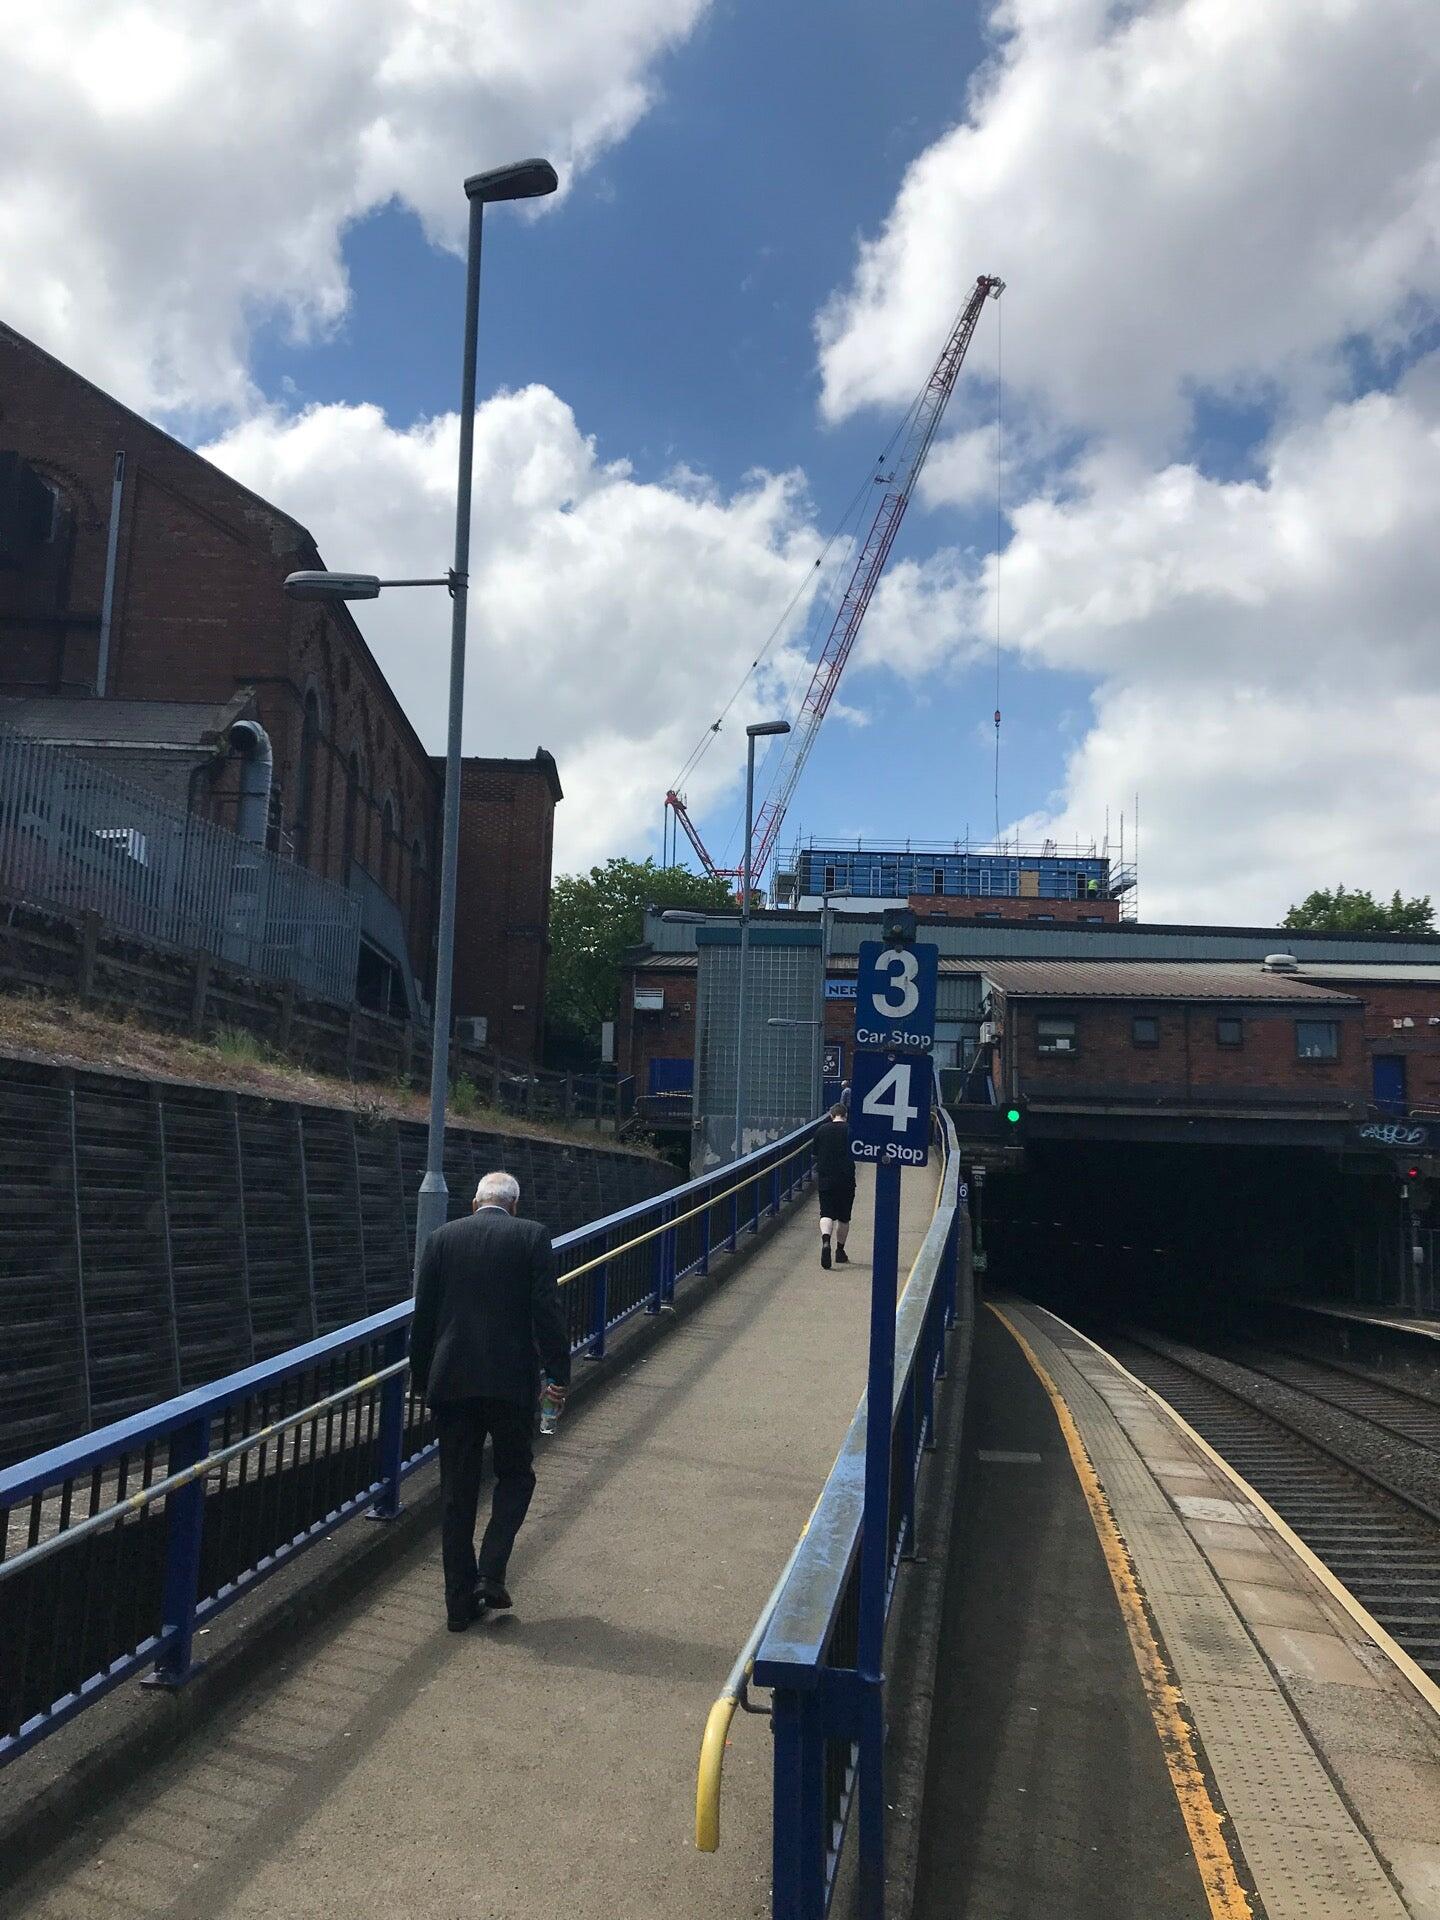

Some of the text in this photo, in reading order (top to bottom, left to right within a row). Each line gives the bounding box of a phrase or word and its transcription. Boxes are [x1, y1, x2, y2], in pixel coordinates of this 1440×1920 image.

[872, 949, 919, 1018] 3
[856, 1028, 931, 1049] Car Stop
[862, 1063, 918, 1132] 4
[851, 1139, 924, 1164] Car Stop
[960, 1185, 967, 1197] 6
